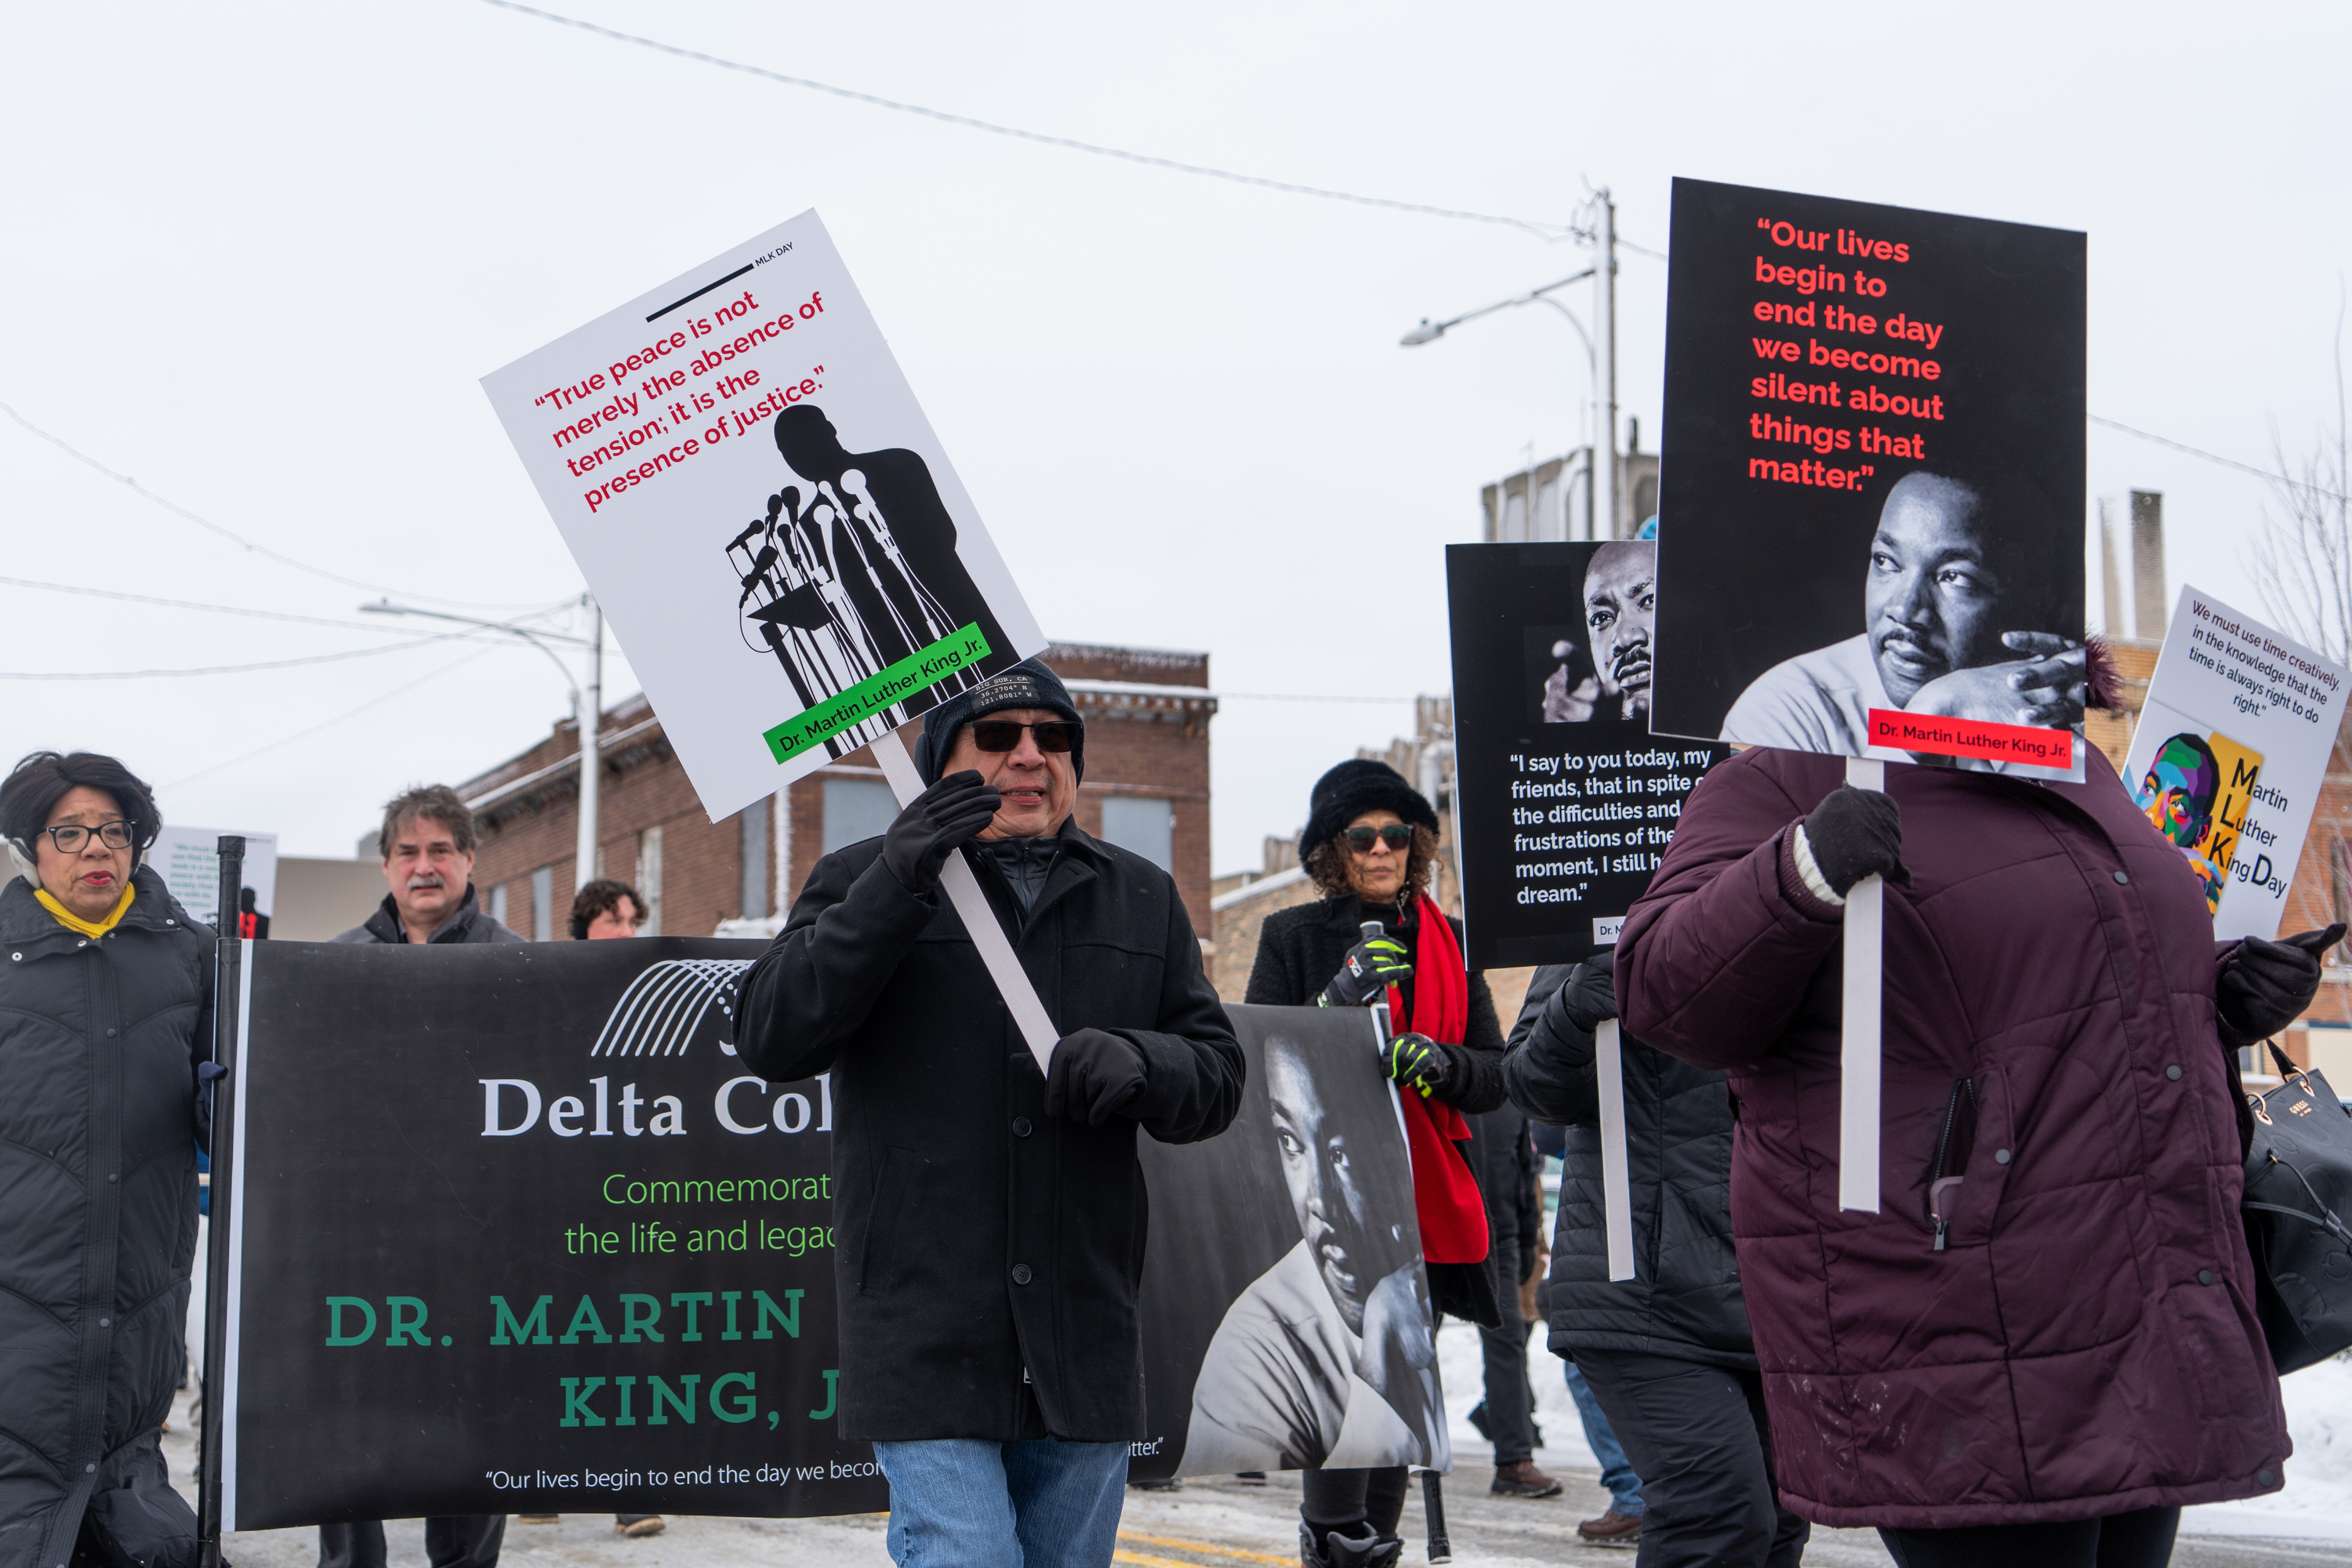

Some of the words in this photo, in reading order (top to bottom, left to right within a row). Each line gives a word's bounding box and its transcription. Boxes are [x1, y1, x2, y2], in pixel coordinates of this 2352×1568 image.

[755, 252, 776, 267] MLK
[775, 241, 793, 256] DAY
[1758, 218, 1830, 251] “Our
[1838, 229, 1909, 263] lives
[1756, 256, 1846, 295] begin
[1854, 270, 1886, 297] to
[1754, 301, 1815, 327] end
[1824, 305, 1877, 334] the
[1885, 314, 1943, 350] day
[535, 375, 604, 409] “True
[609, 332, 686, 386] peace
[688, 319, 711, 338] is
[715, 292, 758, 325] not
[553, 393, 638, 448] merely
[642, 371, 685, 399] the
[691, 314, 793, 376] absence
[800, 292, 823, 319] of
[1752, 338, 1801, 361] we
[1809, 339, 1941, 380] become
[1751, 372, 1842, 407] silent
[1849, 385, 1944, 420] about
[567, 417, 668, 477] tension;
[668, 402, 691, 424] it
[690, 393, 714, 412] is
[717, 370, 760, 399] the
[585, 440, 699, 513] presence
[705, 416, 728, 444] of
[731, 365, 823, 436] justice.”
[1750, 413, 1851, 454] things
[1859, 427, 1925, 459] that
[1749, 459, 1874, 491] matter.”
[2192, 625, 2204, 641] in
[2206, 632, 2223, 651] the
[2226, 642, 2285, 682] knowledge
[2288, 675, 2308, 695] that
[2310, 687, 2327, 704] the
[2194, 601, 2210, 619] We
[2212, 615, 2240, 636] must
[2242, 630, 2261, 647] use
[2263, 639, 2287, 660] time
[2289, 655, 2339, 691] creatively,
[779, 734, 804, 752] Dr.
[804, 704, 861, 739] Martin
[861, 672, 917, 709] Luther
[920, 651, 961, 677] King
[965, 641, 982, 656] Jr.
[975, 681, 990, 691] BIG
[981, 684, 1018, 699] 36.2704°
[981, 691, 1022, 706] 121.8081°
[2190, 647, 2214, 669] time
[2216, 660, 2225, 674] is
[2227, 669, 2263, 695] always
[2266, 689, 2290, 709] right
[2292, 700, 2303, 714] to
[2306, 709, 2318, 723] do
[1879, 722, 1899, 736] Dr.
[1904, 726, 1951, 742] Martin
[1958, 733, 2008, 749] Luther
[2013, 739, 2045, 757] King
[2050, 744, 2067, 757] Jr.
[1511, 755, 1523, 771] “I
[1530, 757, 1559, 775] say
[1564, 753, 1583, 769] to
[1588, 755, 1621, 773] you
[1625, 749, 1679, 769] today,
[1684, 751, 1711, 768] my
[1512, 779, 1580, 798] friends,
[1585, 778, 1622, 794] that
[1627, 776, 1642, 793] in
[1648, 774, 1691, 796] spite
[2230, 757, 2288, 812] Martin
[1513, 808, 1544, 825] the
[1549, 803, 1642, 822] difficulties
[1647, 800, 1681, 818] and
[2220, 793, 2278, 848] Luther
[1515, 831, 1621, 851] frustrations
[1625, 828, 1643, 844] of
[1516, 858, 1598, 877] moment,
[1603, 856, 1607, 872] I
[1613, 854, 1646, 872] still
[2208, 831, 2251, 883] King
[2251, 853, 2288, 899] Day
[1518, 883, 1587, 904] dream.”
[1600, 926, 1613, 935] Dr.
[479, 1076, 686, 1136] Delta
[604, 1174, 831, 1204] Commemorat
[565, 1223, 619, 1254] the
[632, 1221, 676, 1253] life
[688, 1220, 746, 1252] and
[760, 1220, 835, 1257] legac
[326, 1297, 452, 1346] DR.
[490, 1290, 804, 1345] MARTIN
[561, 1372, 779, 1430] KING,
[486, 1472, 530, 1489] “Our
[538, 1470, 578, 1487] lives
[586, 1469, 641, 1490] begin
[648, 1471, 667, 1485] to
[674, 1465, 710, 1484] end
[718, 1465, 750, 1483] the
[757, 1464, 790, 1486] day
[797, 1467, 824, 1480] we
[831, 1460, 884, 1479] beco
